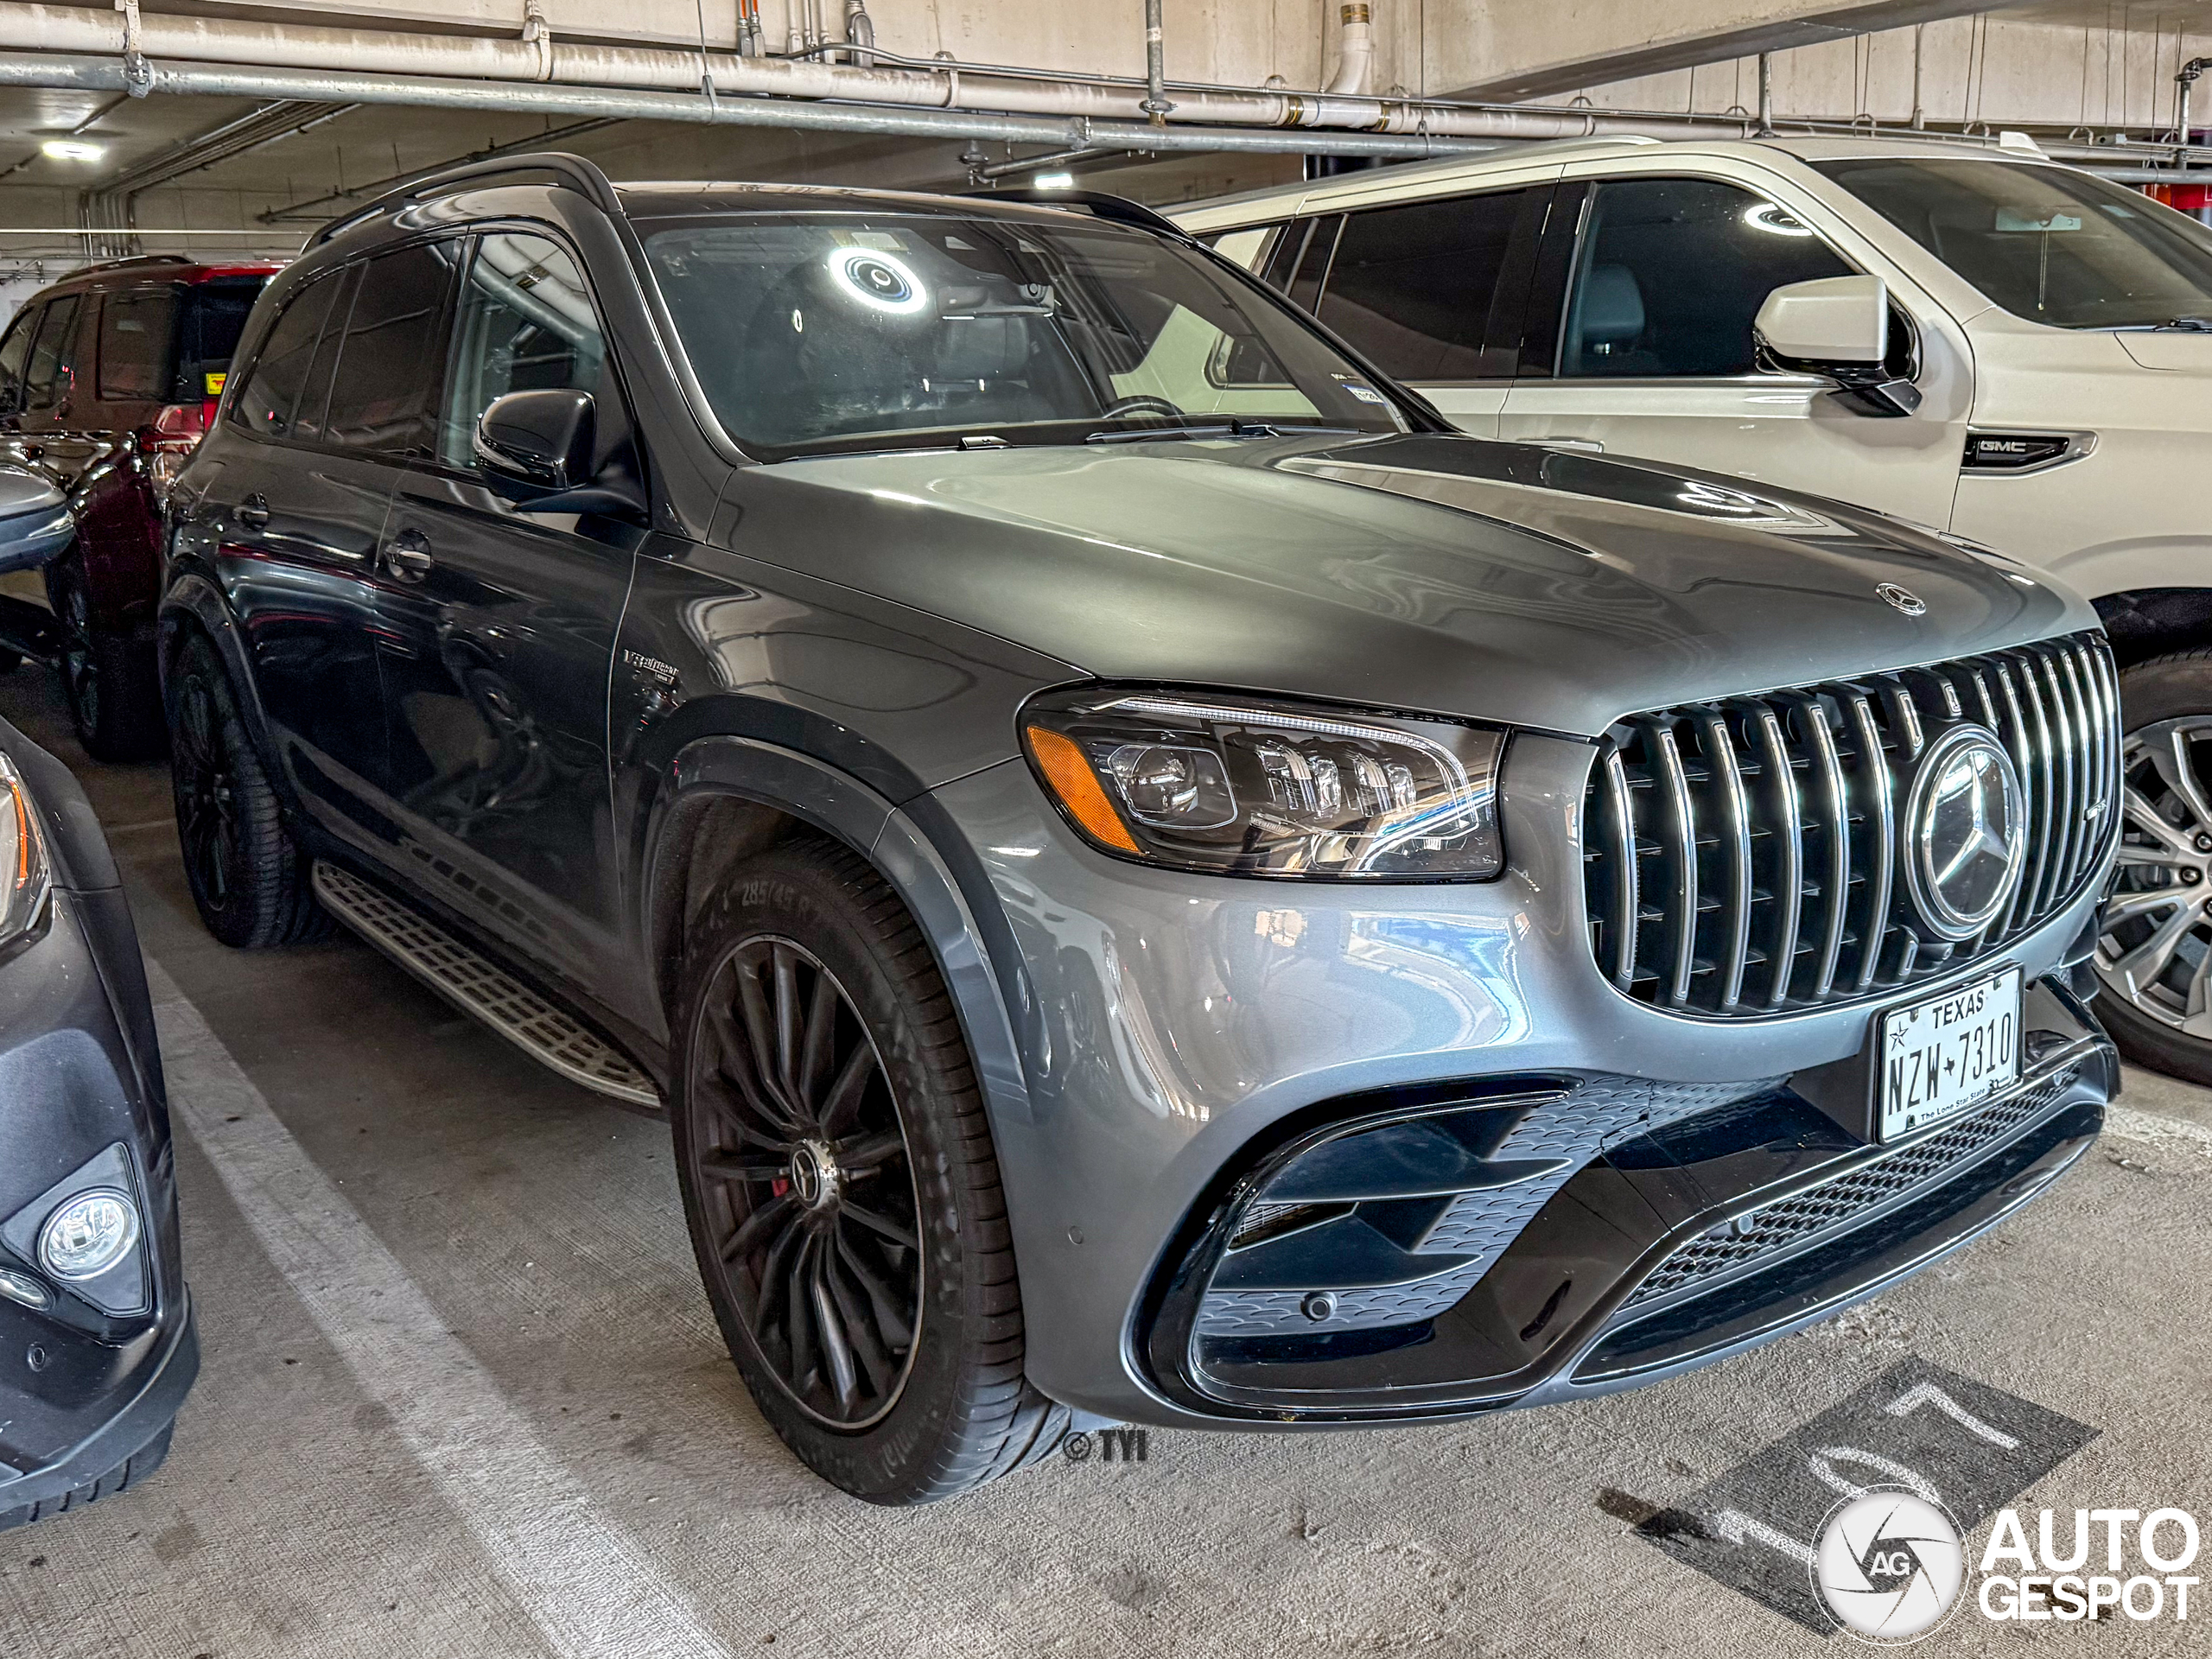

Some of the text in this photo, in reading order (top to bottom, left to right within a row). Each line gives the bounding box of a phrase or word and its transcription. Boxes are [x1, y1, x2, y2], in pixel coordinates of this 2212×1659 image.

[1980, 440, 2026, 453] GMC
[1932, 989, 1985, 1029] TEXAS
[1888, 1012, 2012, 1116] NZW 7310
[1921, 1088, 1986, 1121] The Lone Star State
